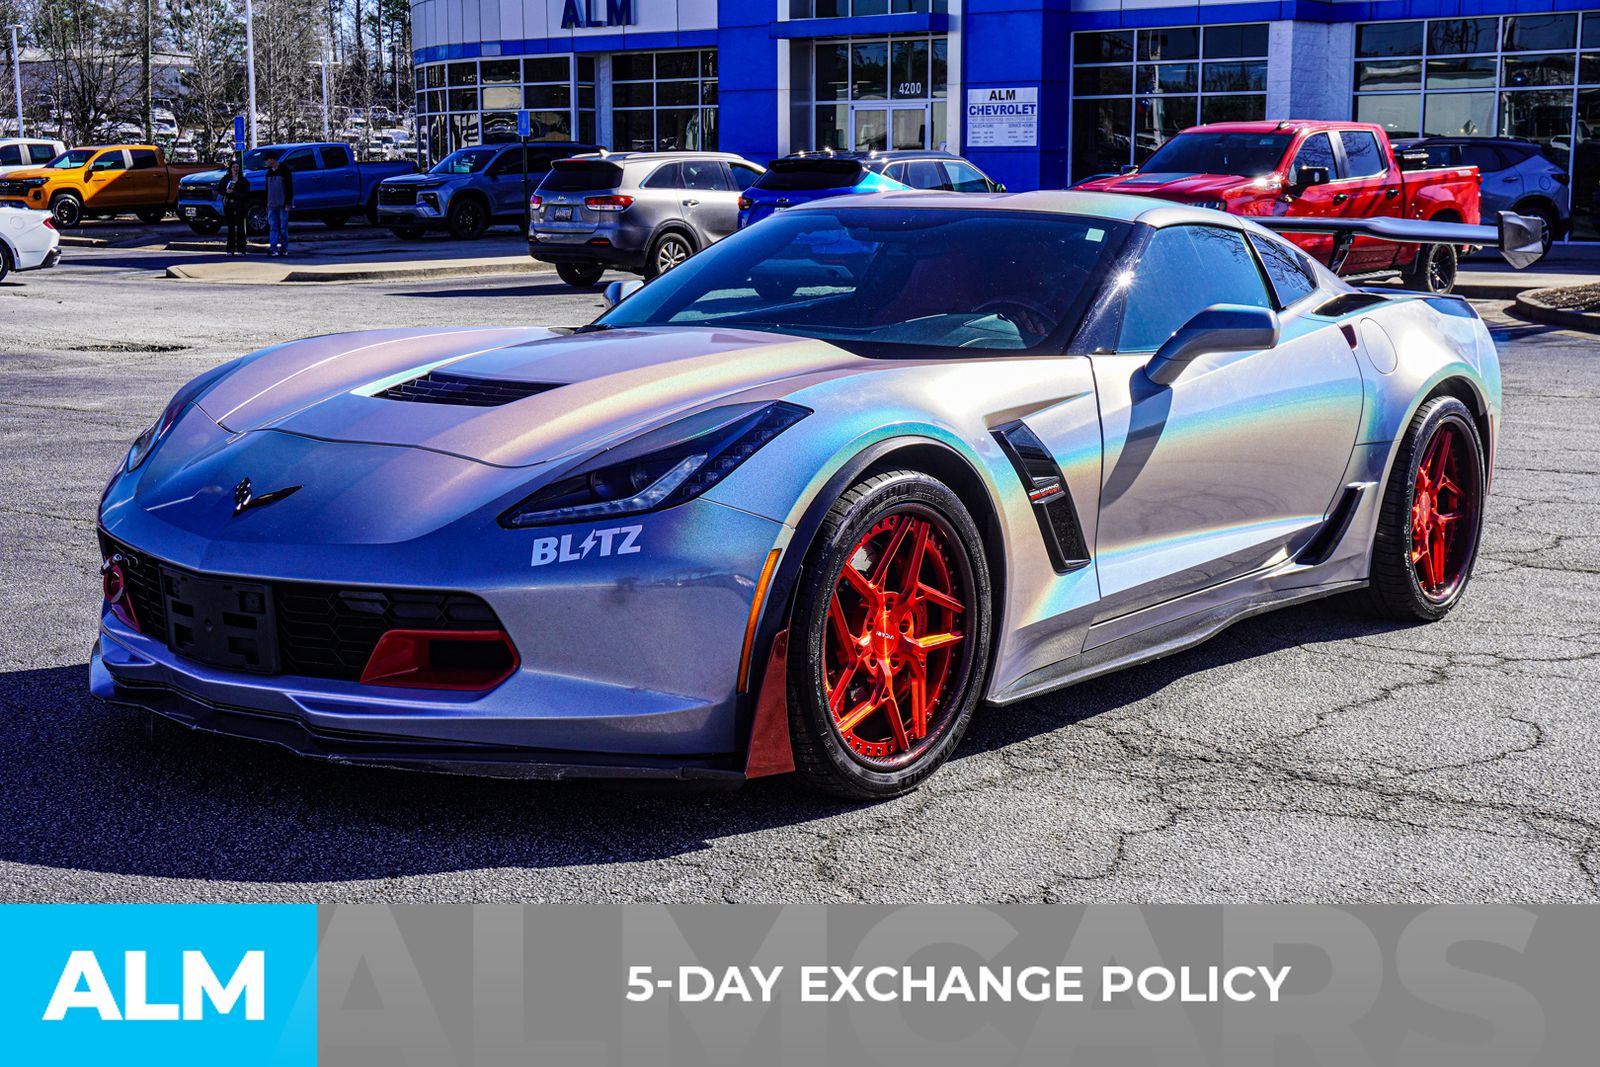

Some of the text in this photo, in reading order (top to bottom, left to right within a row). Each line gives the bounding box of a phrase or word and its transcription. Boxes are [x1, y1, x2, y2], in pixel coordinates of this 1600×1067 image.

[561, 0, 637, 29] ALM
[898, 82, 922, 95] 4200
[989, 90, 1016, 101] ALM
[969, 104, 1036, 115] CHEVROLET
